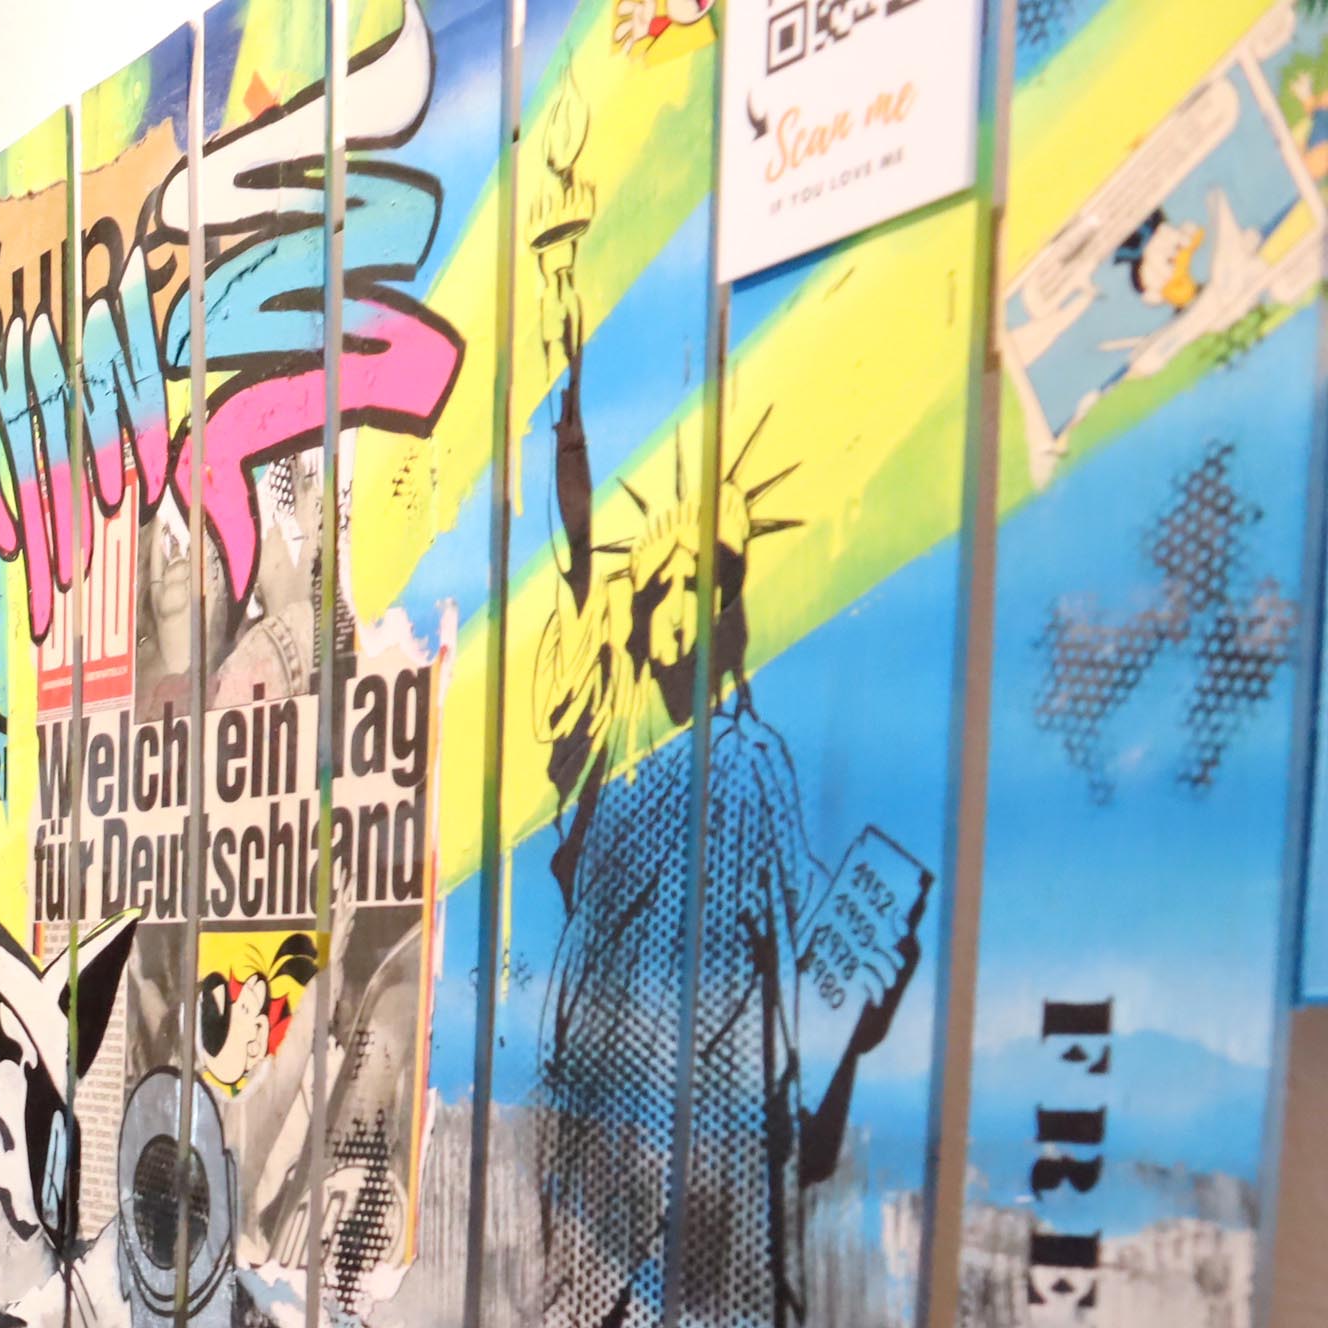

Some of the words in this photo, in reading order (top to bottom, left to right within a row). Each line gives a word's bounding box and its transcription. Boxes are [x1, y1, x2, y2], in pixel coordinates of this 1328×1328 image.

[765, 106, 852, 183] Scan
[865, 81, 915, 127] me
[792, 182, 823, 205] YOU
[830, 161, 872, 191] LOVE
[36, 704, 189, 820] Welch
[216, 683, 298, 803] ein
[310, 653, 431, 788] Tag
[34, 819, 95, 921] für
[100, 789, 426, 920] Deutschland
[808, 953, 845, 1010] 980
